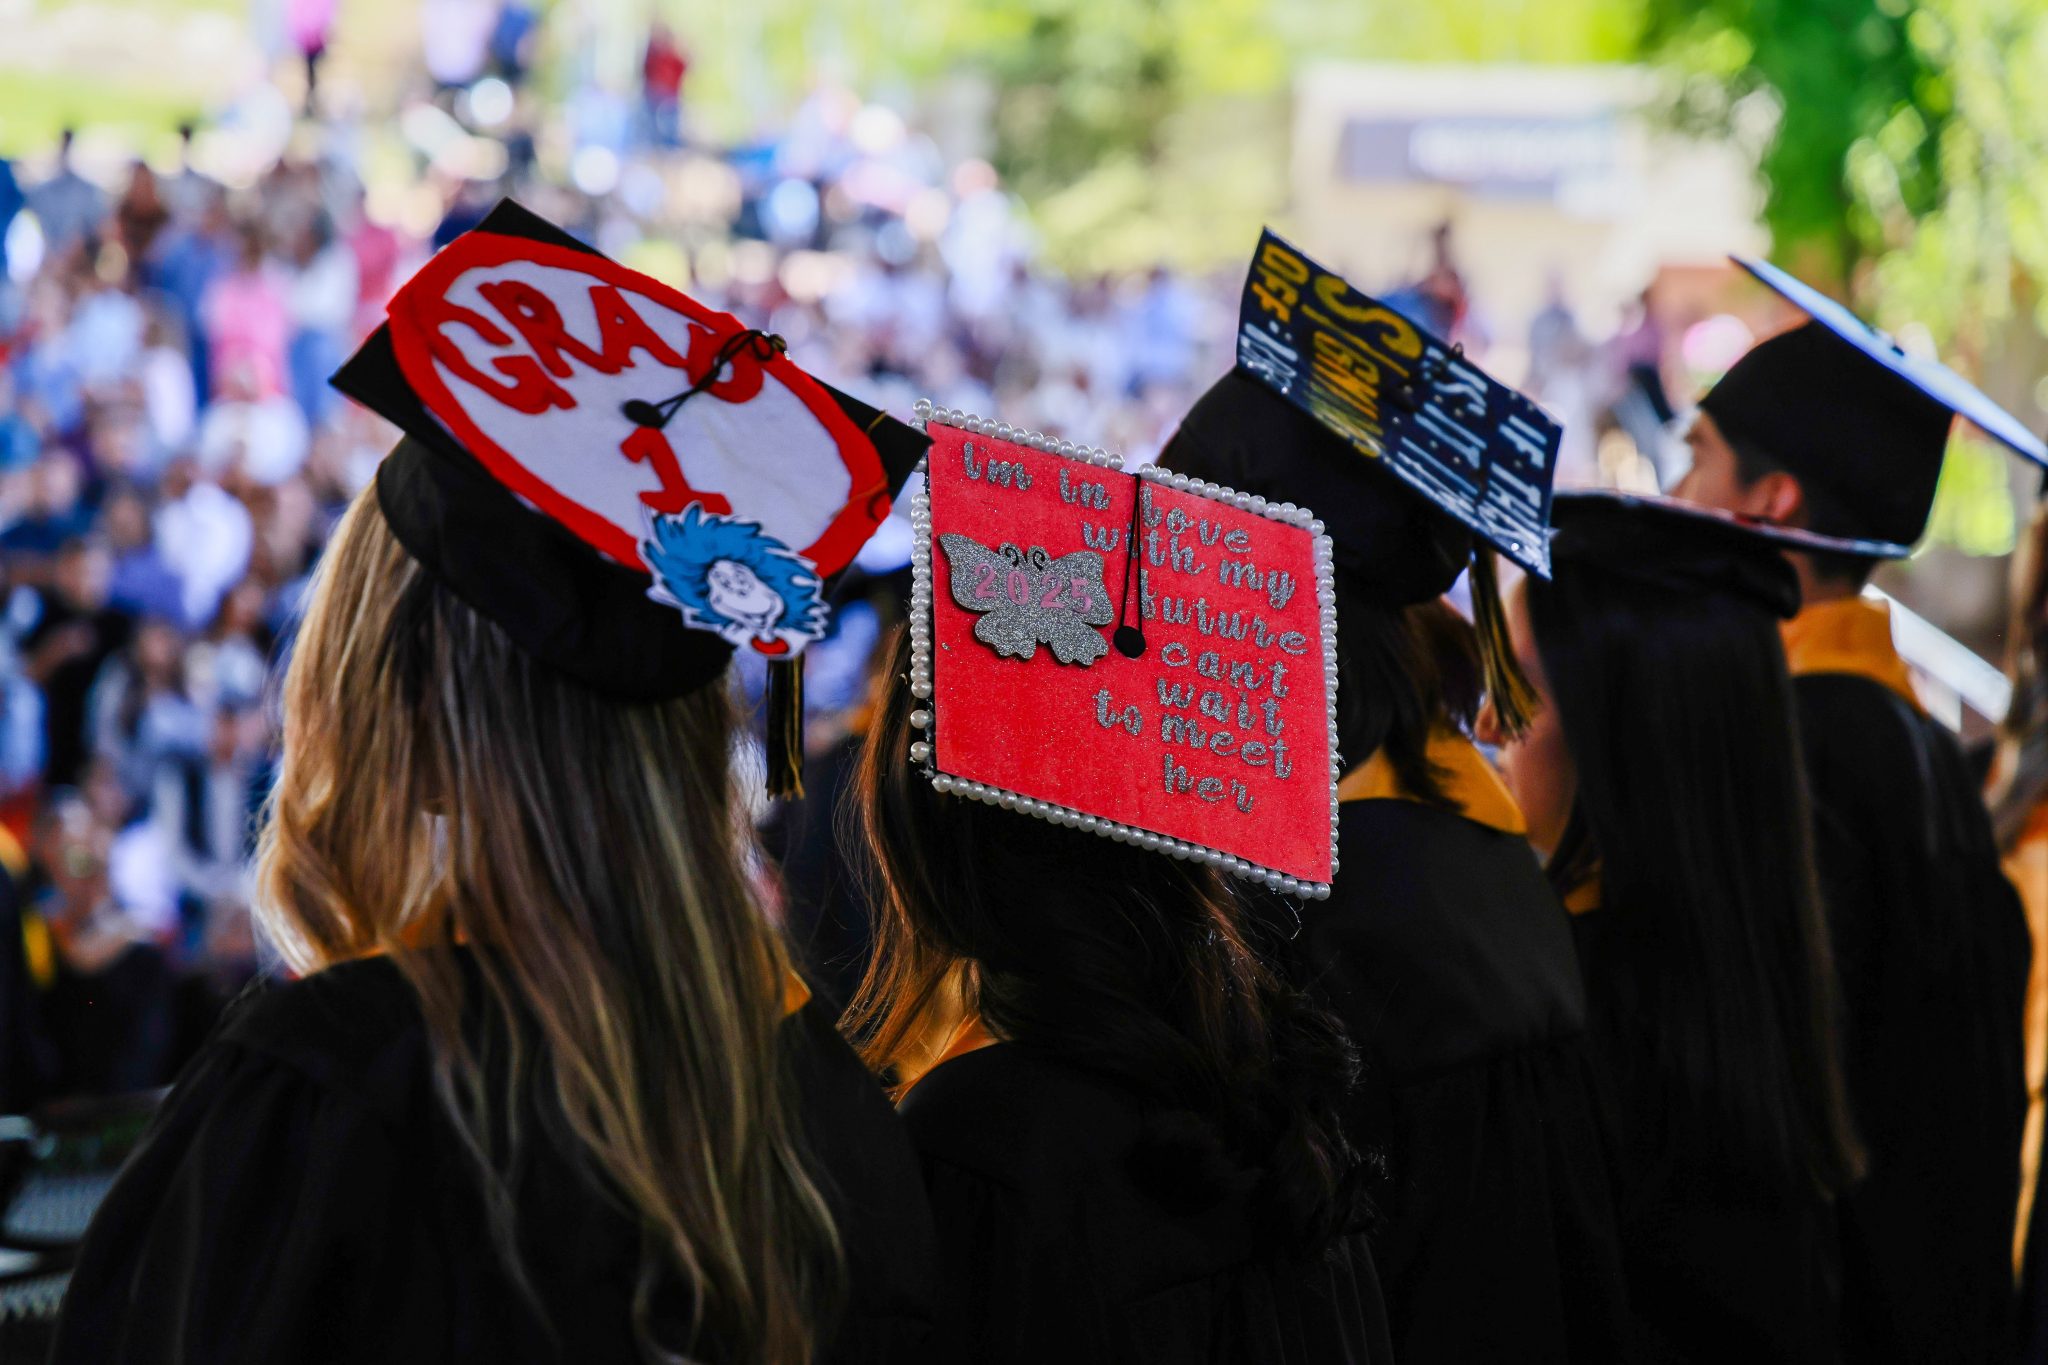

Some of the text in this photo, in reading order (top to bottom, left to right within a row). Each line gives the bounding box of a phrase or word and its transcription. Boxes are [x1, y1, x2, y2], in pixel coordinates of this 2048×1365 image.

[1251, 243, 1309, 322] OFF
[425, 280, 764, 414] GRAD
[621, 426, 732, 515] 1
[1499, 414, 1548, 469] IF
[974, 563, 1093, 614] 2025
[1083, 522, 1295, 609] with my
[1140, 568, 1307, 655] future
[1093, 689, 1292, 779] to meet
[1157, 678, 1284, 737] wait
[1164, 753, 1254, 813] her
